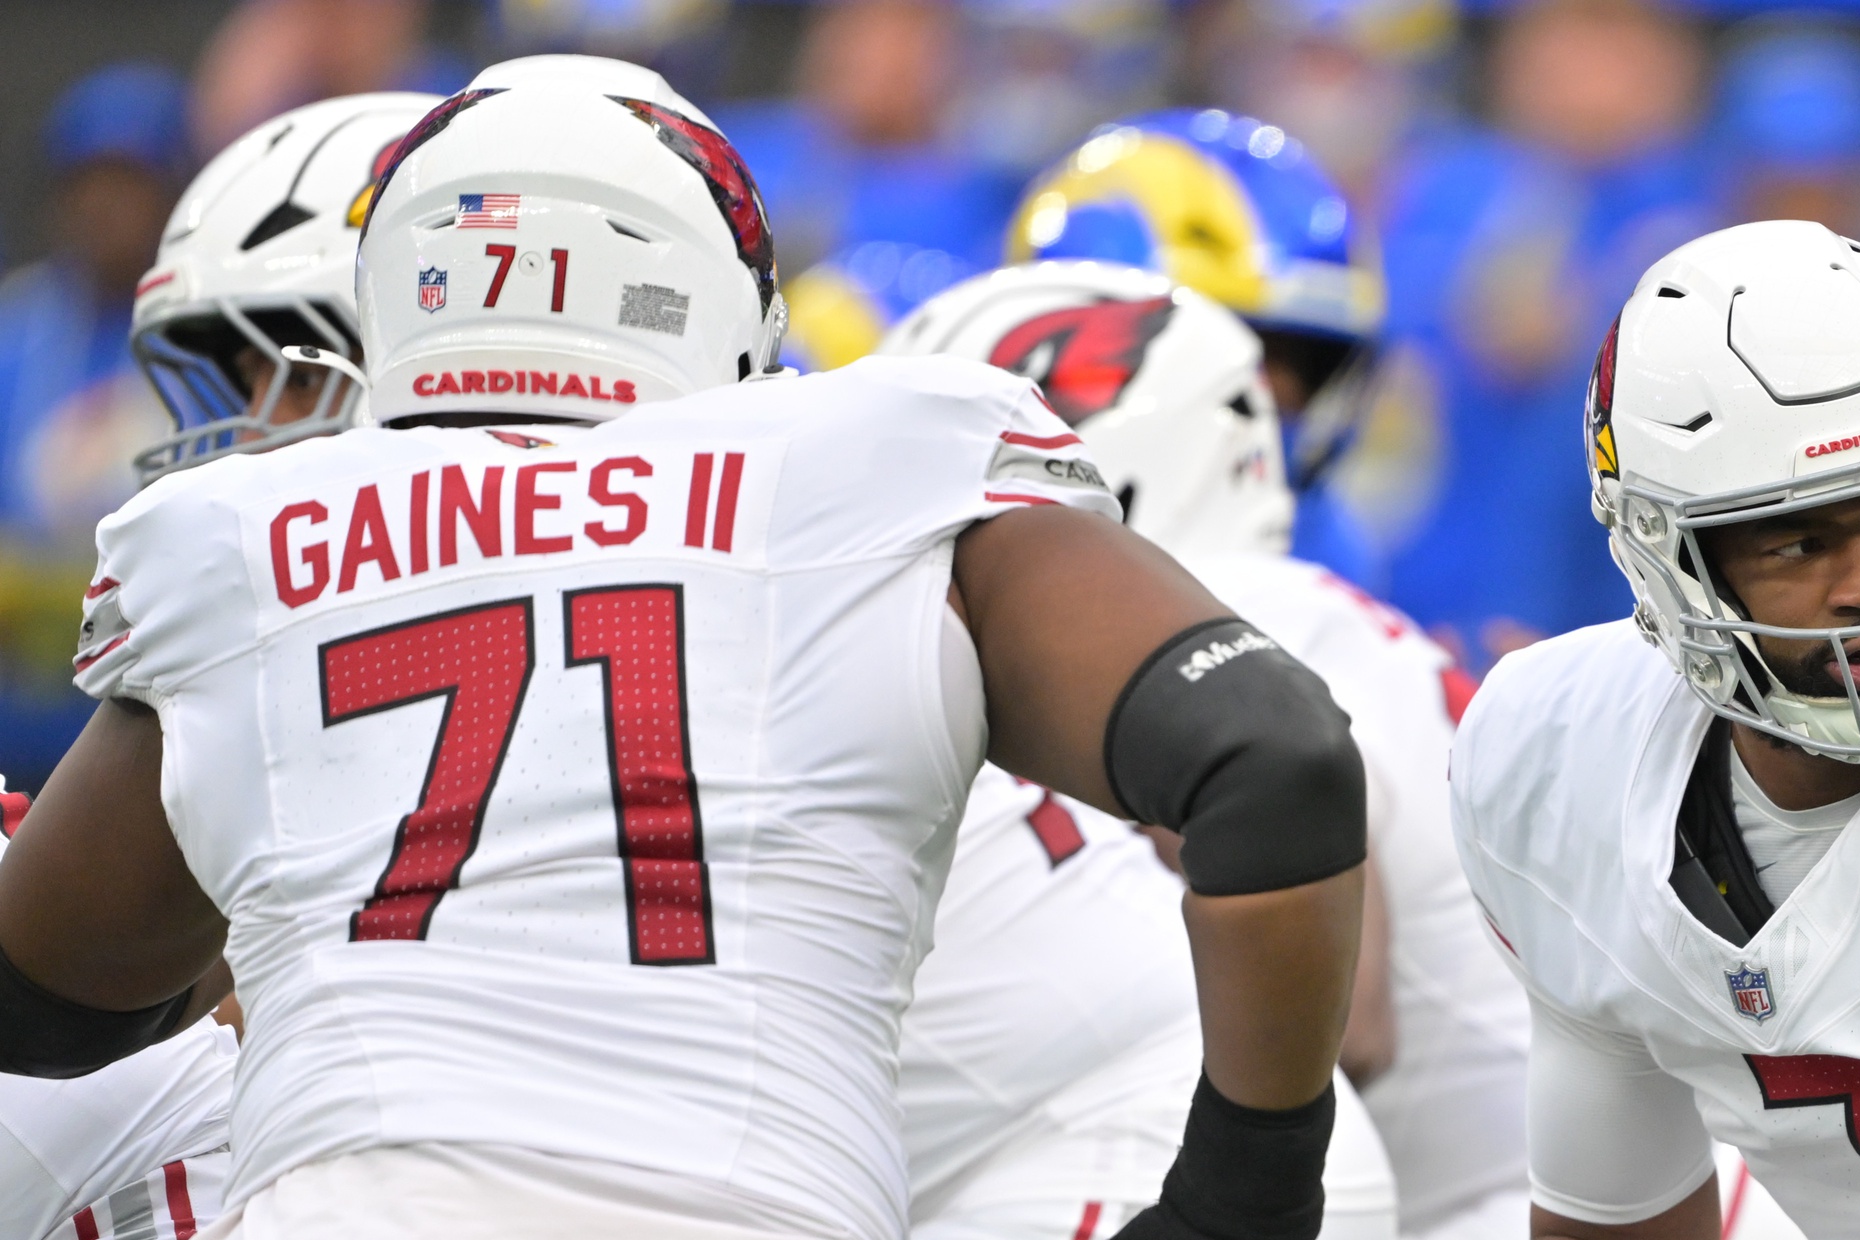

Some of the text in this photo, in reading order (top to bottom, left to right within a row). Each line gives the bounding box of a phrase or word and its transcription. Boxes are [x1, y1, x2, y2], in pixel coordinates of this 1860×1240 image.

[420, 285, 445, 307] NFL
[482, 243, 569, 312] 71
[412, 370, 637, 404] CARDINALS
[270, 452, 746, 610] GAINES II
[318, 583, 715, 967] 71
[1736, 989, 1770, 1014] NFL
